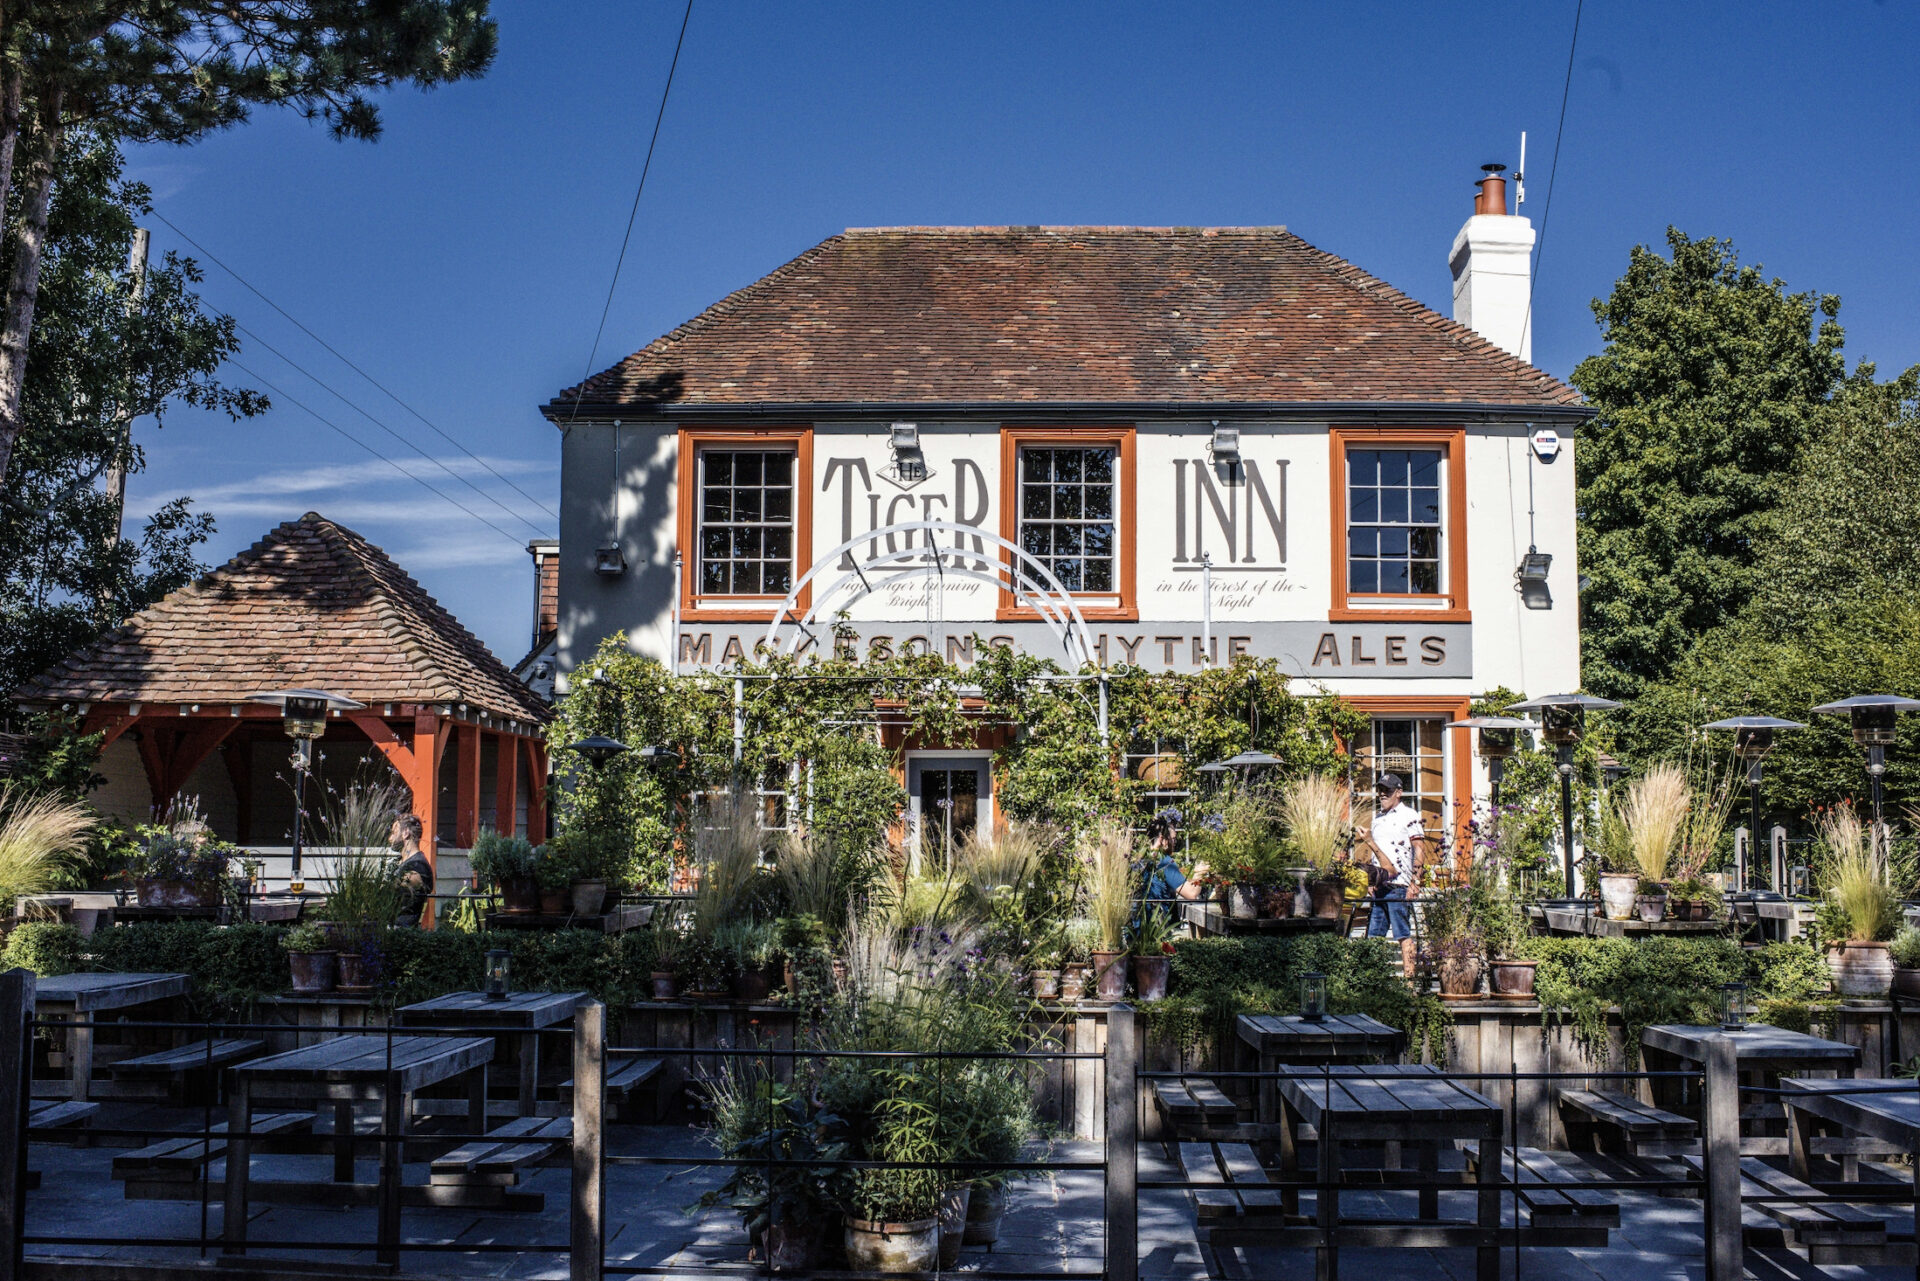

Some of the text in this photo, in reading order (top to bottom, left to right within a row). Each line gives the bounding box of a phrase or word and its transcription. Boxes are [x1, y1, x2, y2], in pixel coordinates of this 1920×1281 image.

[890, 462, 922, 481] THE
[822, 457, 989, 571] TIGER
[1172, 459, 1290, 563] INN
[1155, 580, 1172, 592] in
[1178, 579, 1199, 592] the
[1253, 580, 1268, 595] of
[889, 594, 932, 612] Bright
[1212, 594, 1255, 612] Night
[1080, 633, 1252, 666] HYTHE
[1311, 632, 1446, 667] ALES
